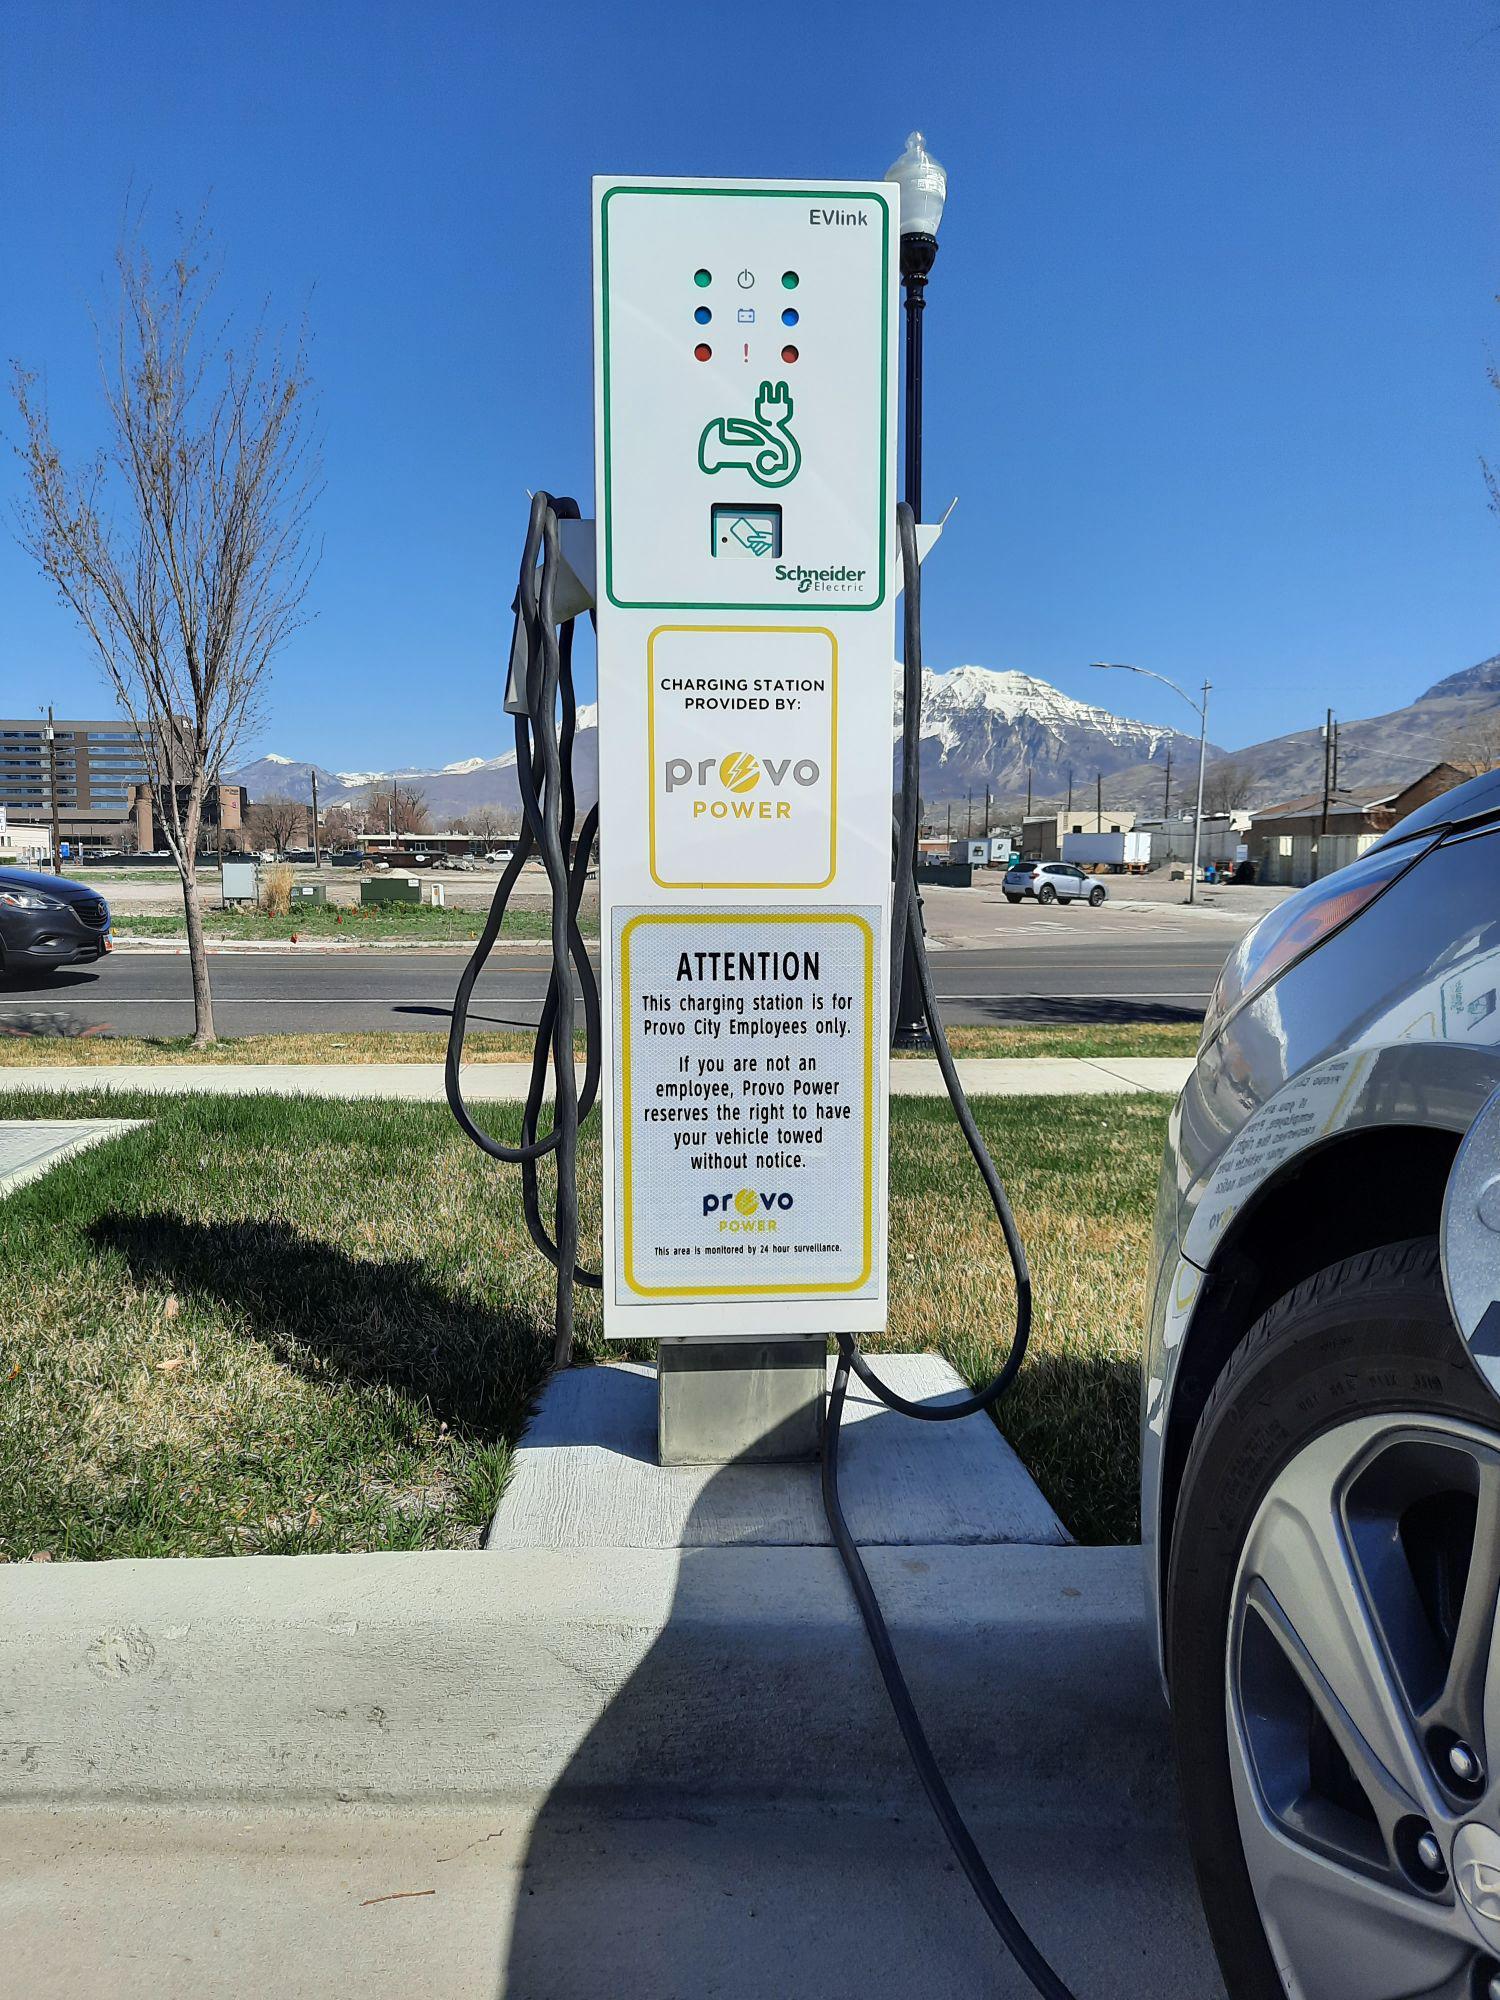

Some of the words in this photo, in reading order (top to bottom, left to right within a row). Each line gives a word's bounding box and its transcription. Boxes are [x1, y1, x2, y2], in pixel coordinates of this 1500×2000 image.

[810, 210, 867, 226] EVlink
[775, 565, 866, 581] Schneider
[814, 582, 864, 591] Electric
[661, 679, 748, 691] CHARGING
[754, 679, 824, 691] STATION
[685, 698, 769, 709] PROVIDED
[776, 699, 801, 710] BY:
[666, 752, 820, 793] provo
[693, 801, 791, 818] POWER
[676, 952, 819, 981] ATTENTION
[642, 994, 671, 1011] This
[680, 994, 744, 1014] charging
[753, 994, 803, 1010] station
[812, 994, 823, 1010] is
[832, 994, 852, 1010] for
[644, 1019, 685, 1035] Provo
[694, 1019, 720, 1038] City
[730, 1019, 807, 1038] Employees
[816, 1017, 851, 1037] only.
[679, 1056, 689, 1072] If
[698, 1058, 724, 1076] you
[734, 1058, 757, 1072] are
[766, 1056, 790, 1071] not
[799, 1058, 816, 1070] an
[656, 1080, 734, 1100] employee,
[743, 1080, 784, 1095] Provo
[794, 1079, 839, 1095] Power
[644, 1105, 708, 1121] reserves
[717, 1104, 740, 1120] the
[750, 1103, 784, 1124] right
[793, 1104, 807, 1119] to
[816, 1103, 851, 1119] have
[674, 1130, 706, 1149] your
[716, 1128, 768, 1144] vehicle
[777, 1127, 823, 1144] towed
[691, 1152, 748, 1169] without
[756, 1151, 806, 1169] notice.
[703, 1188, 793, 1216] provo
[719, 1220, 777, 1232] POWER
[654, 1247, 669, 1256] This
[674, 1247, 690, 1255] area
[694, 1246, 700, 1255] is
[705, 1245, 743, 1254] monitored
[748, 1245, 756, 1255] by
[760, 1245, 769, 1253] 24
[773, 1245, 790, 1253] hour
[794, 1243, 841, 1253] surveillance.
